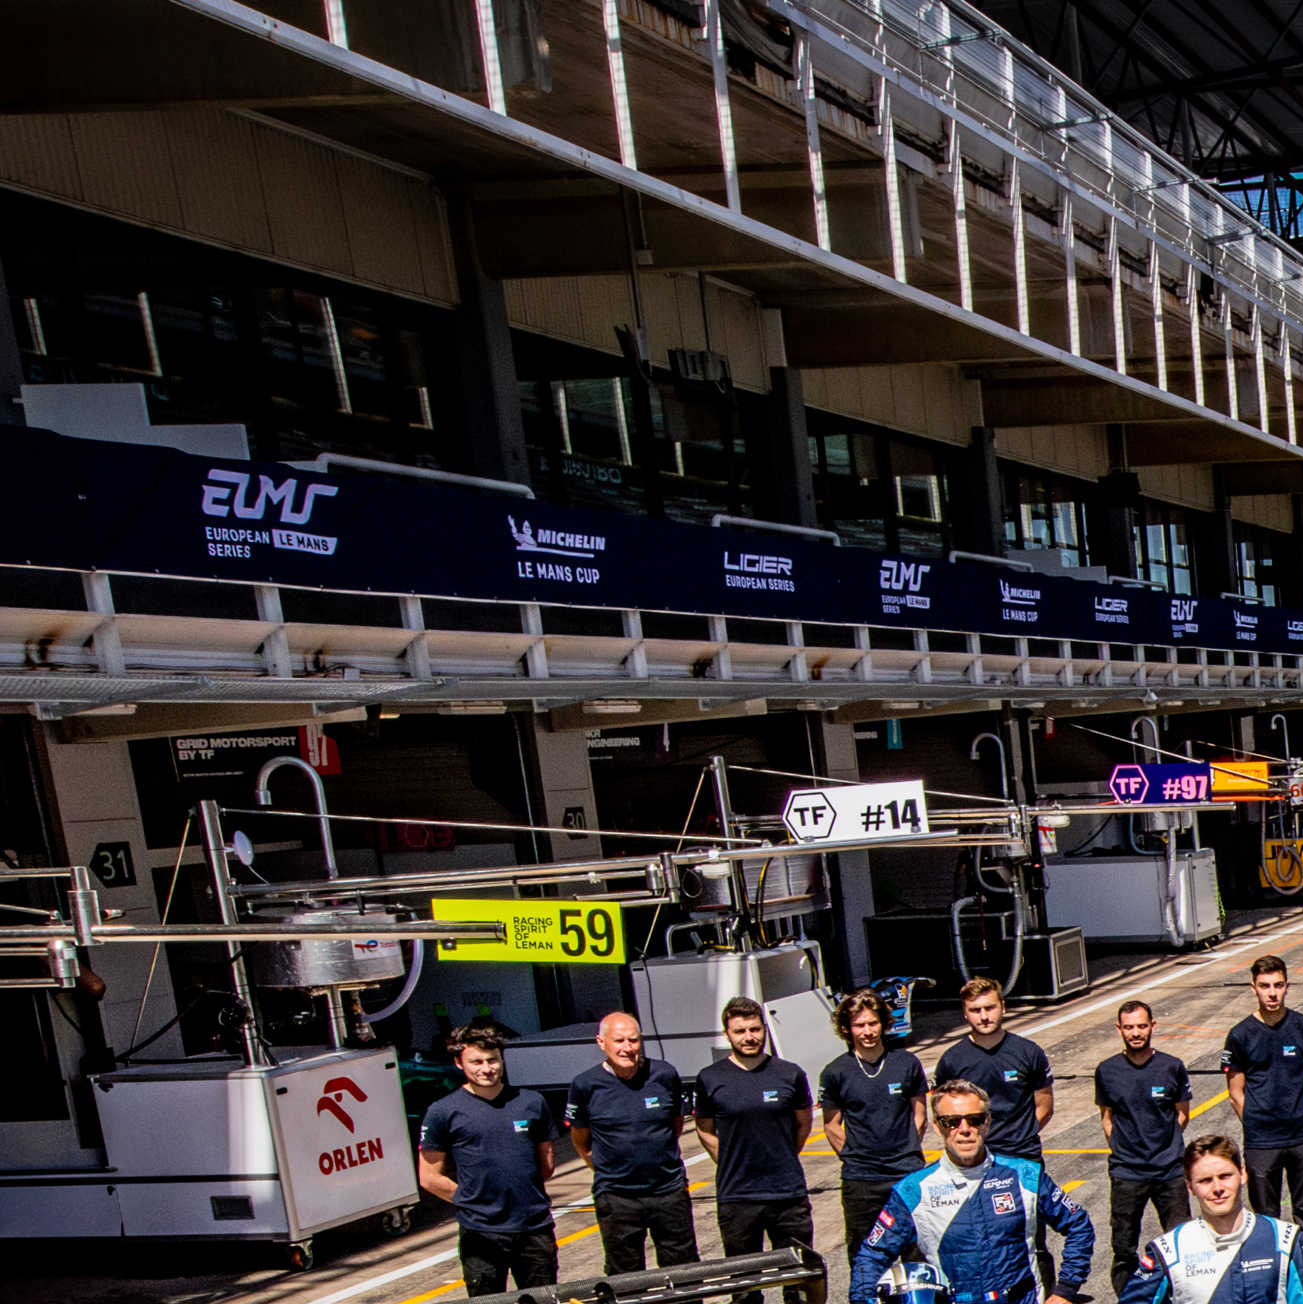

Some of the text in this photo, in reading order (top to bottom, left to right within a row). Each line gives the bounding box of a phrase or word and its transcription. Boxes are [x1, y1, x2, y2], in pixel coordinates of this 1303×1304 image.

[202, 468, 338, 525] ELMS
[205, 526, 329, 552] EUROPEAN LE MANS
[207, 542, 252, 559] SERIES
[537, 528, 606, 551] MICHELIN
[517, 561, 600, 584] LE MANS CUP
[724, 551, 793, 575] LIGIER
[725, 573, 795, 593] EUROPEAN SERIES
[176, 736, 297, 750] GRID MOTORSPORT
[587, 736, 640, 749] NGINEERING
[178, 750, 215, 761] BY TF
[1115, 777, 1142, 796] TF
[1162, 775, 1208, 800] #97
[567, 810, 584, 831] 30
[793, 798, 921, 832] TF #14
[99, 849, 129, 881] 31
[513, 916, 553, 927] RACING
[514, 925, 548, 935] SPIRIT
[558, 908, 615, 957] 59
[515, 933, 529, 943] OF
[318, 1137, 384, 1176] ORLEN
